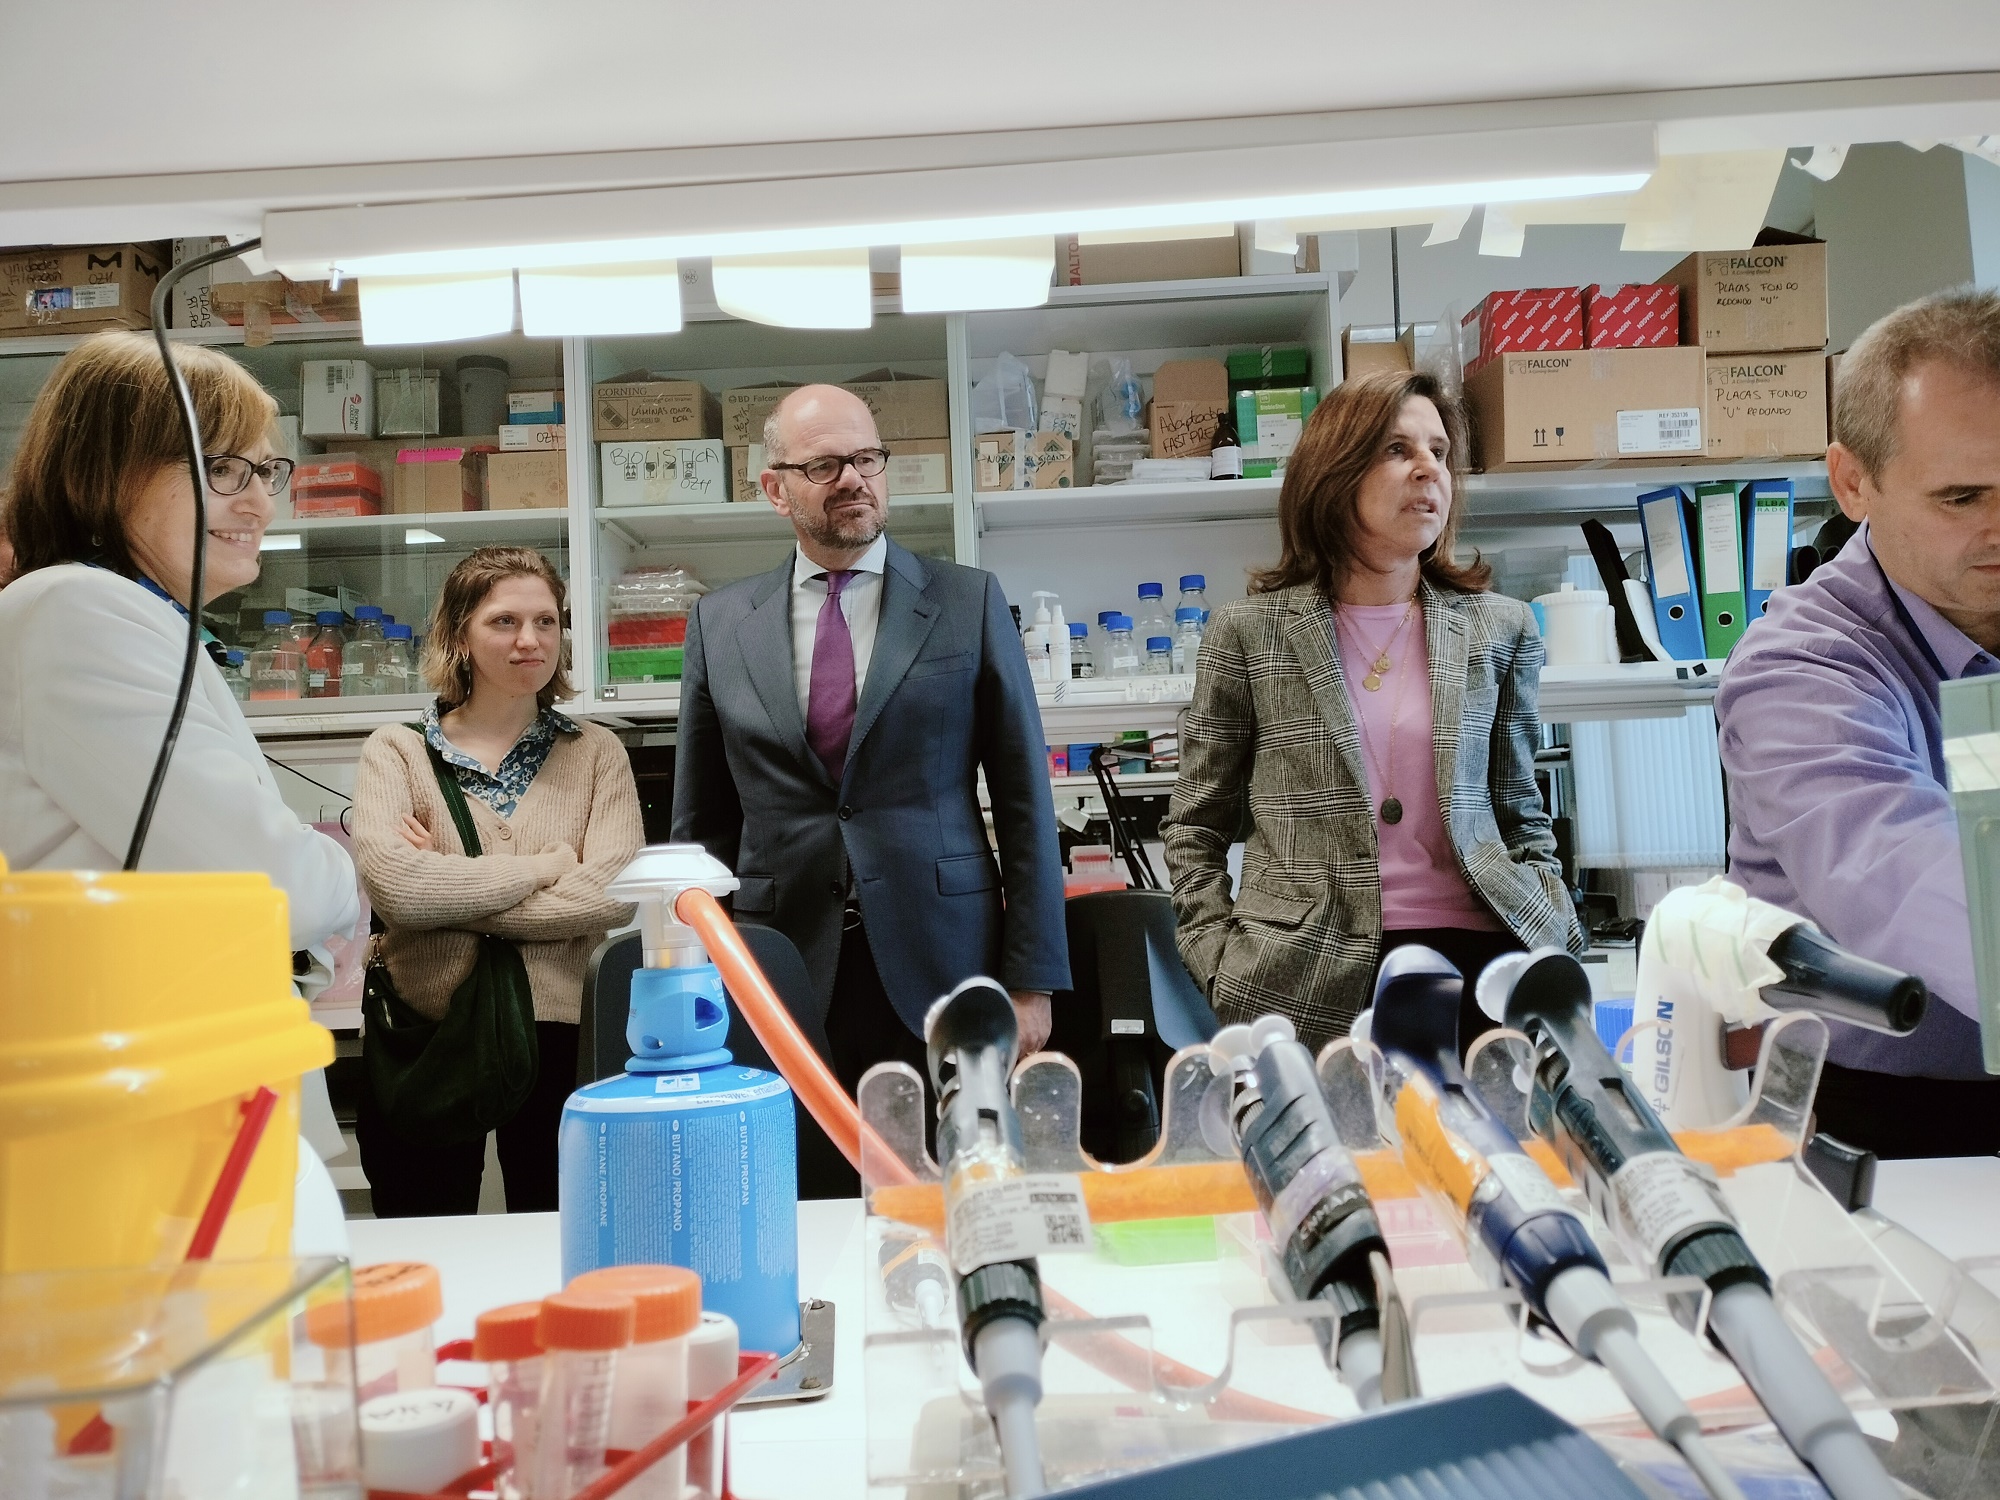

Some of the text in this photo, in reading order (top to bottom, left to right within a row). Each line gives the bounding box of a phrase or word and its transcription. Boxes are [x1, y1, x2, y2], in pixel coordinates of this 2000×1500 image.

[1730, 256, 1784, 268] FALCON
[1715, 281, 1750, 294] PLACAS
[1528, 359, 1569, 368] FALCON
[1730, 365, 1784, 378] FALCON
[598, 387, 647, 397] CORNING
[1715, 388, 1761, 401] PLACAS
